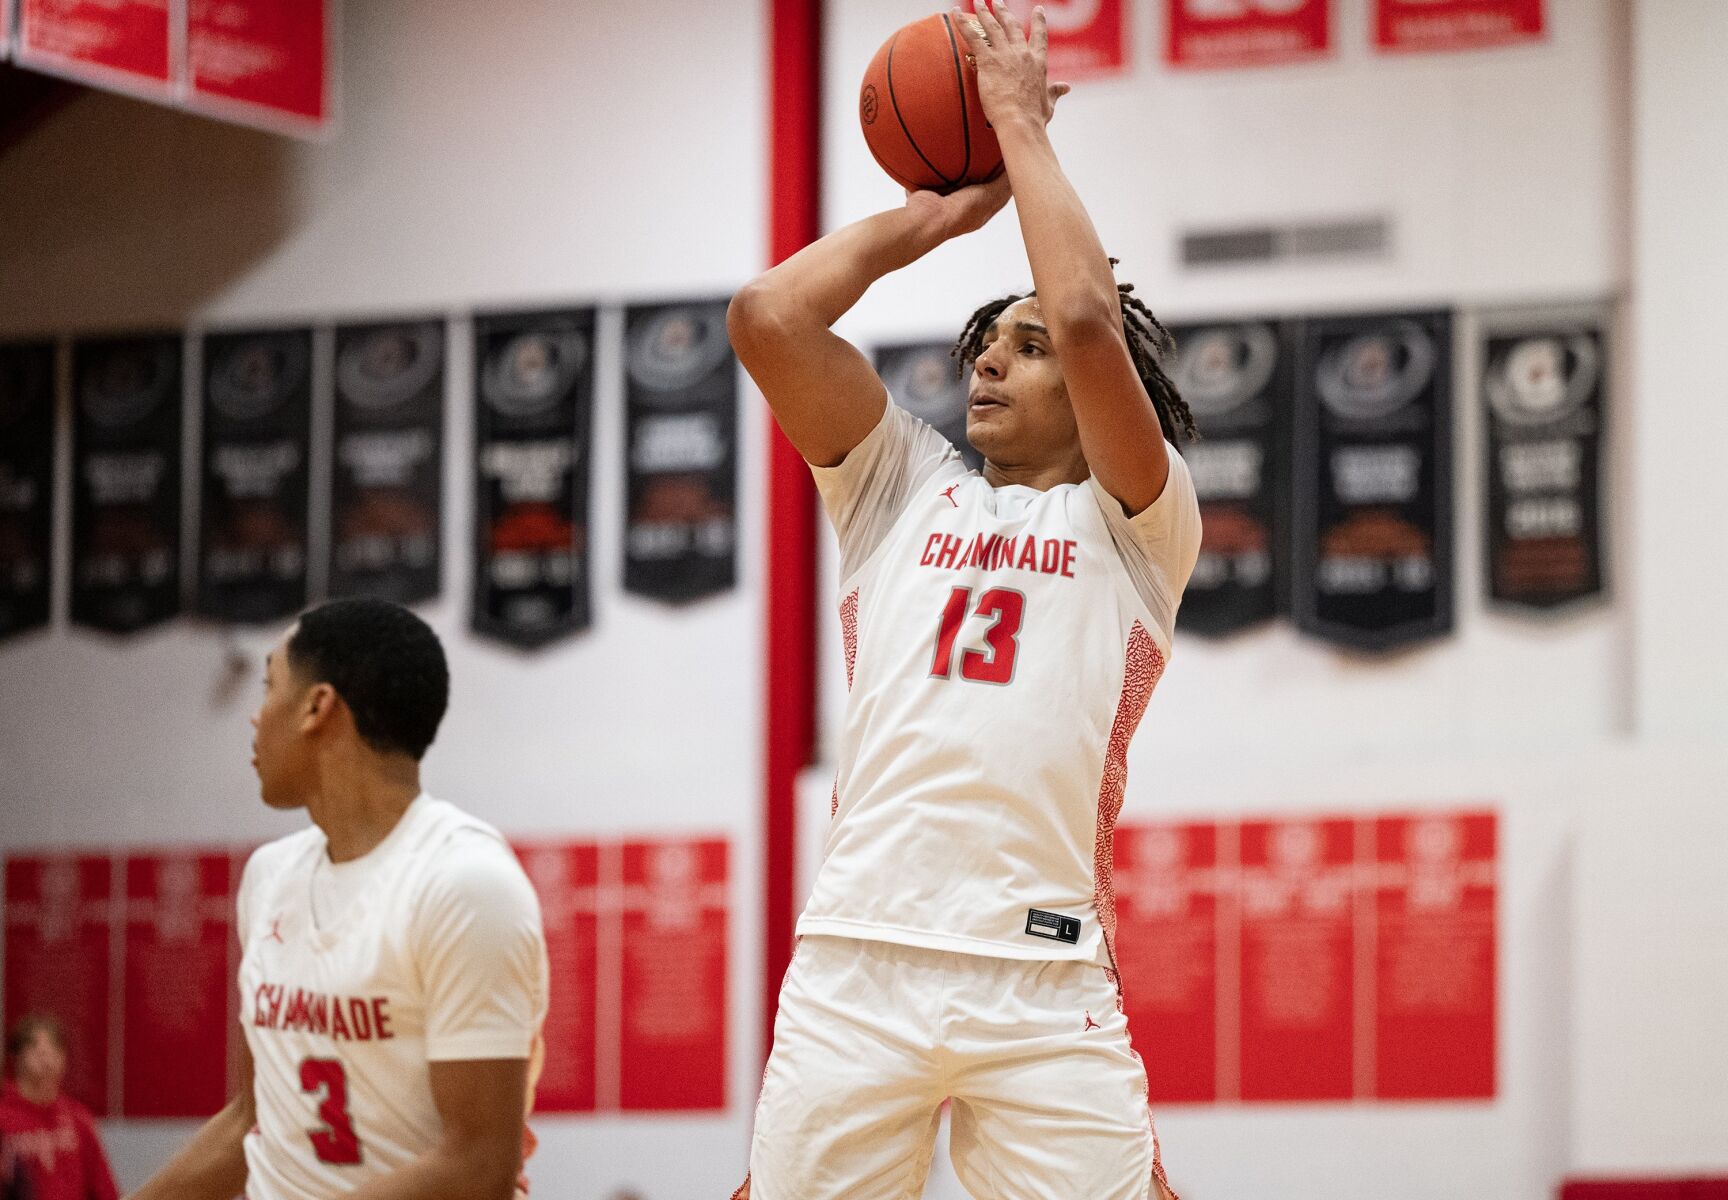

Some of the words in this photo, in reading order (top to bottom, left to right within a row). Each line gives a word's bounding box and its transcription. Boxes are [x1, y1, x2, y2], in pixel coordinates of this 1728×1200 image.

[928, 585, 1027, 687] 13
[1065, 923, 1072, 936] L
[299, 1055, 363, 1166] 3
